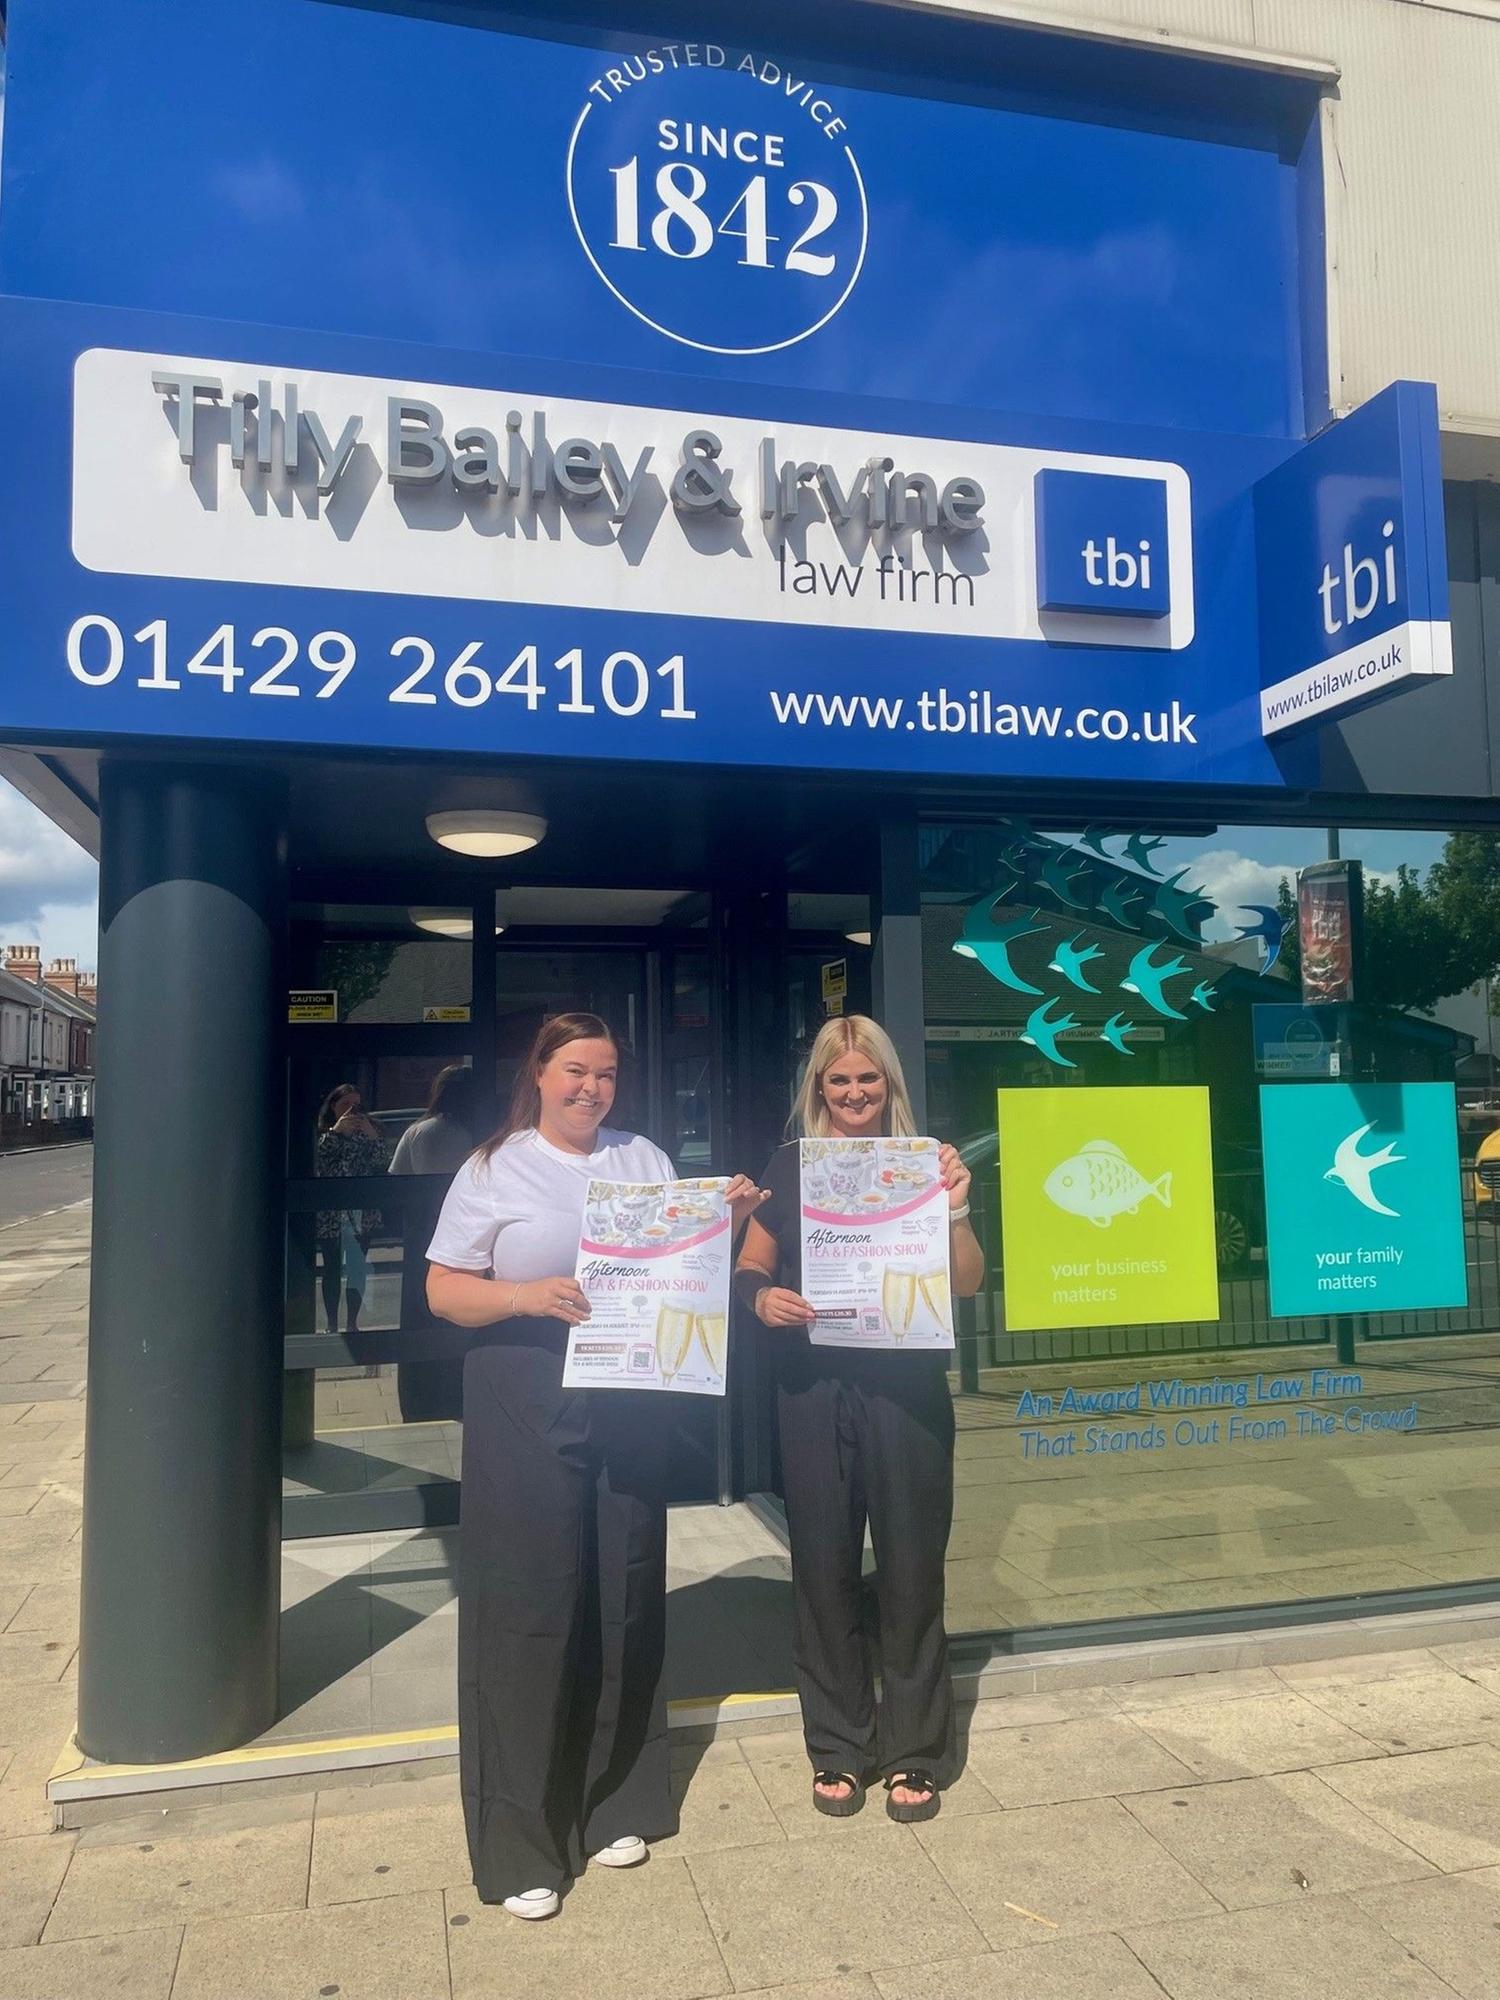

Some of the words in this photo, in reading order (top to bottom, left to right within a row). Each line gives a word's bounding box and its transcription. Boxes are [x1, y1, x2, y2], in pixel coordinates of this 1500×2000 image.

[589, 44, 725, 103] TRUSTED
[737, 54, 847, 139] ADVICE
[658, 119, 785, 167] SINCE
[608, 155, 838, 276] 1842
[151, 370, 363, 496] Tilly
[387, 396, 655, 523] Bailey
[670, 429, 742, 517] &
[759, 437, 985, 531] Irvine
[780, 544, 863, 597] law
[876, 555, 975, 606] firm
[1082, 537, 1151, 590] tbi
[1317, 519, 1397, 635] tbi
[66, 614, 357, 699] 01429
[388, 635, 698, 719] 264101
[1266, 644, 1402, 720] www.tbilaw.co.uk
[770, 688, 1198, 744] www.tbilaw.co.uk
[291, 995, 327, 1003] CAUTION
[807, 1229, 872, 1249] Afternoon
[809, 1246, 830, 1258] TEA
[832, 1246, 841, 1257] &
[844, 1245, 892, 1257] FASHION
[894, 1243, 928, 1255] SHOW
[1316, 1250, 1352, 1269] your
[1356, 1246, 1404, 1265] family
[581, 1259, 651, 1280] Afternoon
[582, 1279, 604, 1291] TEA
[607, 1280, 616, 1291] &
[619, 1279, 670, 1291] FASHION
[672, 1280, 709, 1293] SHOW
[1051, 1262, 1090, 1280] your
[1095, 1257, 1167, 1276] business
[1317, 1273, 1377, 1291] matters
[1052, 1286, 1117, 1304] matters
[1015, 1391, 1052, 1419] An
[1059, 1381, 1141, 1415] Award
[1149, 1377, 1248, 1409] Winning
[1257, 1374, 1303, 1399] Law
[1311, 1369, 1363, 1396] Firm
[1019, 1430, 1076, 1459] That
[1084, 1423, 1166, 1454] Stands
[1174, 1418, 1219, 1446] Out
[1228, 1415, 1287, 1443] From
[1295, 1410, 1336, 1437] The
[1343, 1401, 1420, 1433] Crowd
